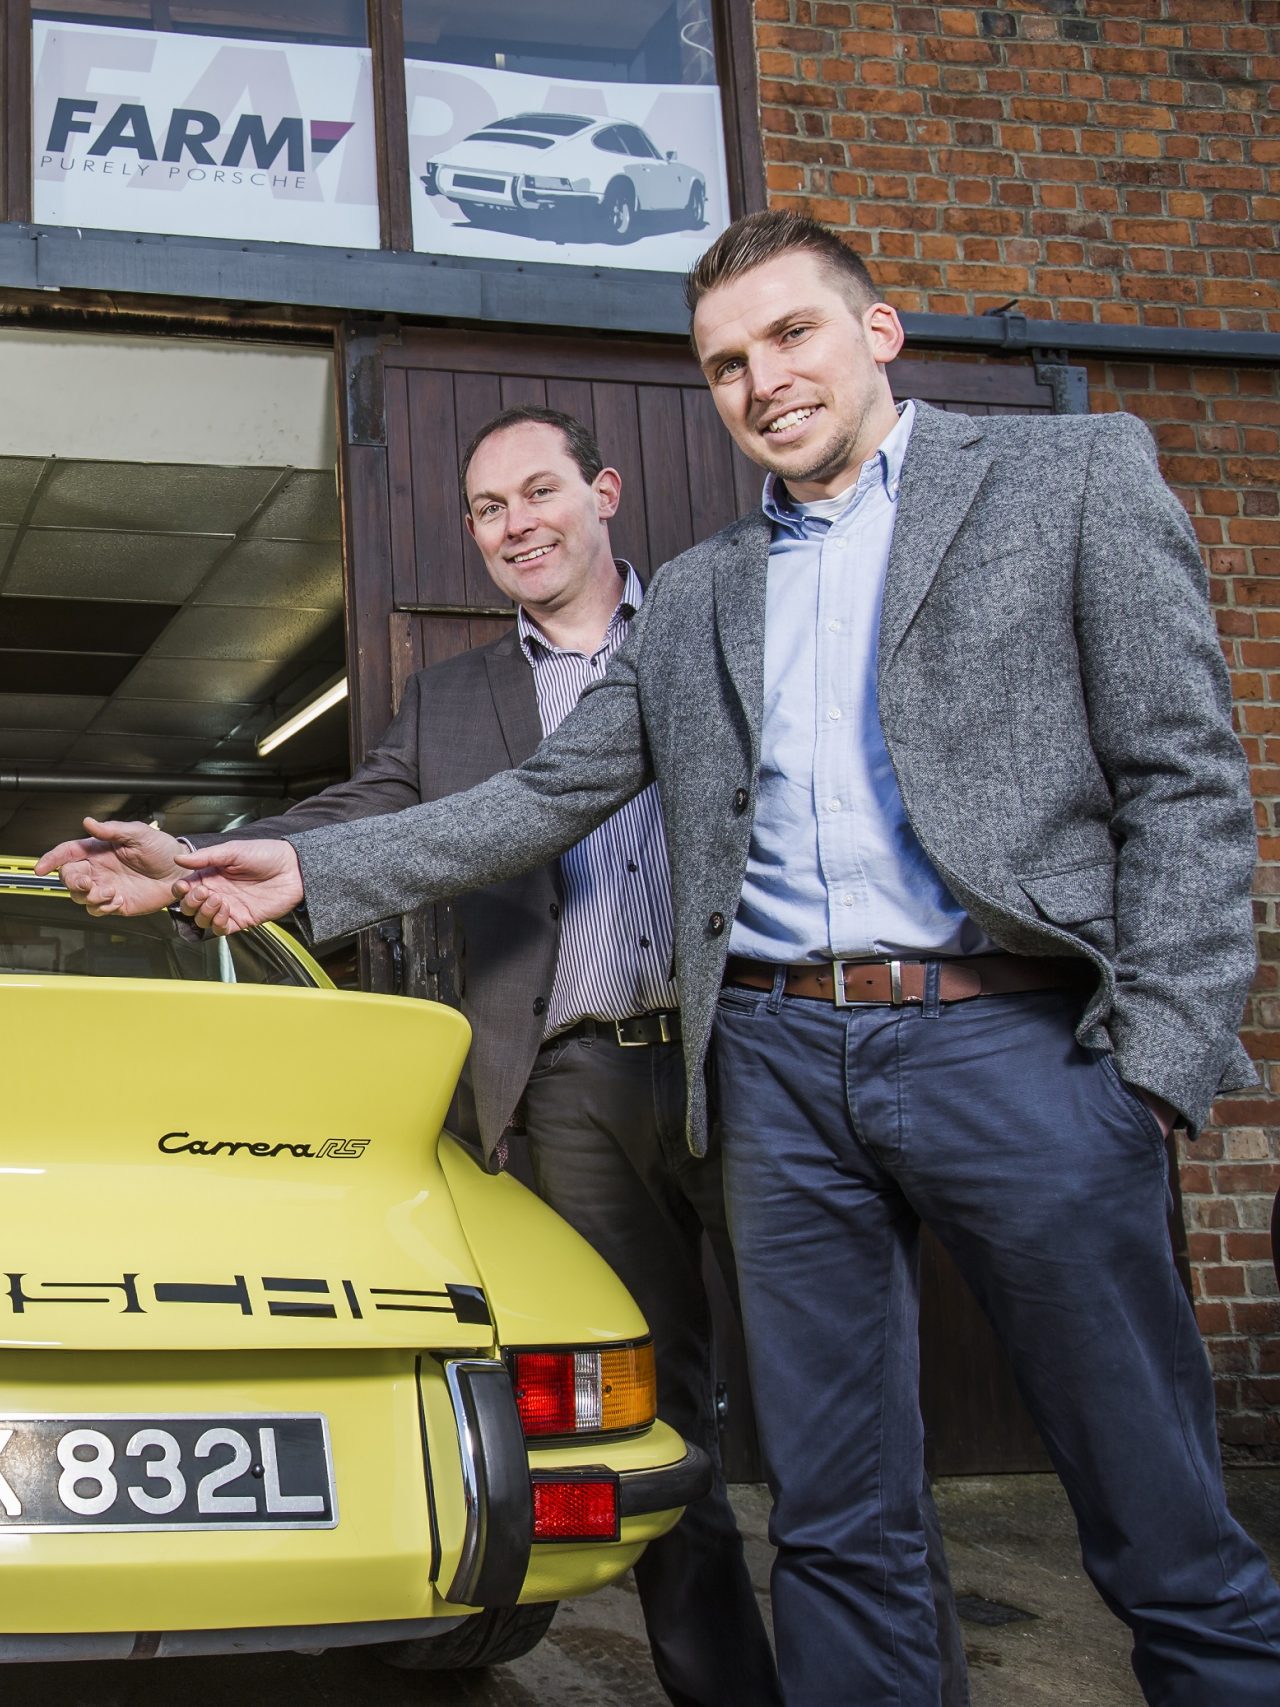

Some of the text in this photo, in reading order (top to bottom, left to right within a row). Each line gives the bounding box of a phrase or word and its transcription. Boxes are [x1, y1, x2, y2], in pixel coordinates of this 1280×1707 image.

[46, 97, 306, 173] FARM
[39, 155, 306, 189] PURELY PORSCHE
[158, 1131, 372, 1159] Carrera RS
[55, 1427, 325, 1515] 832L
